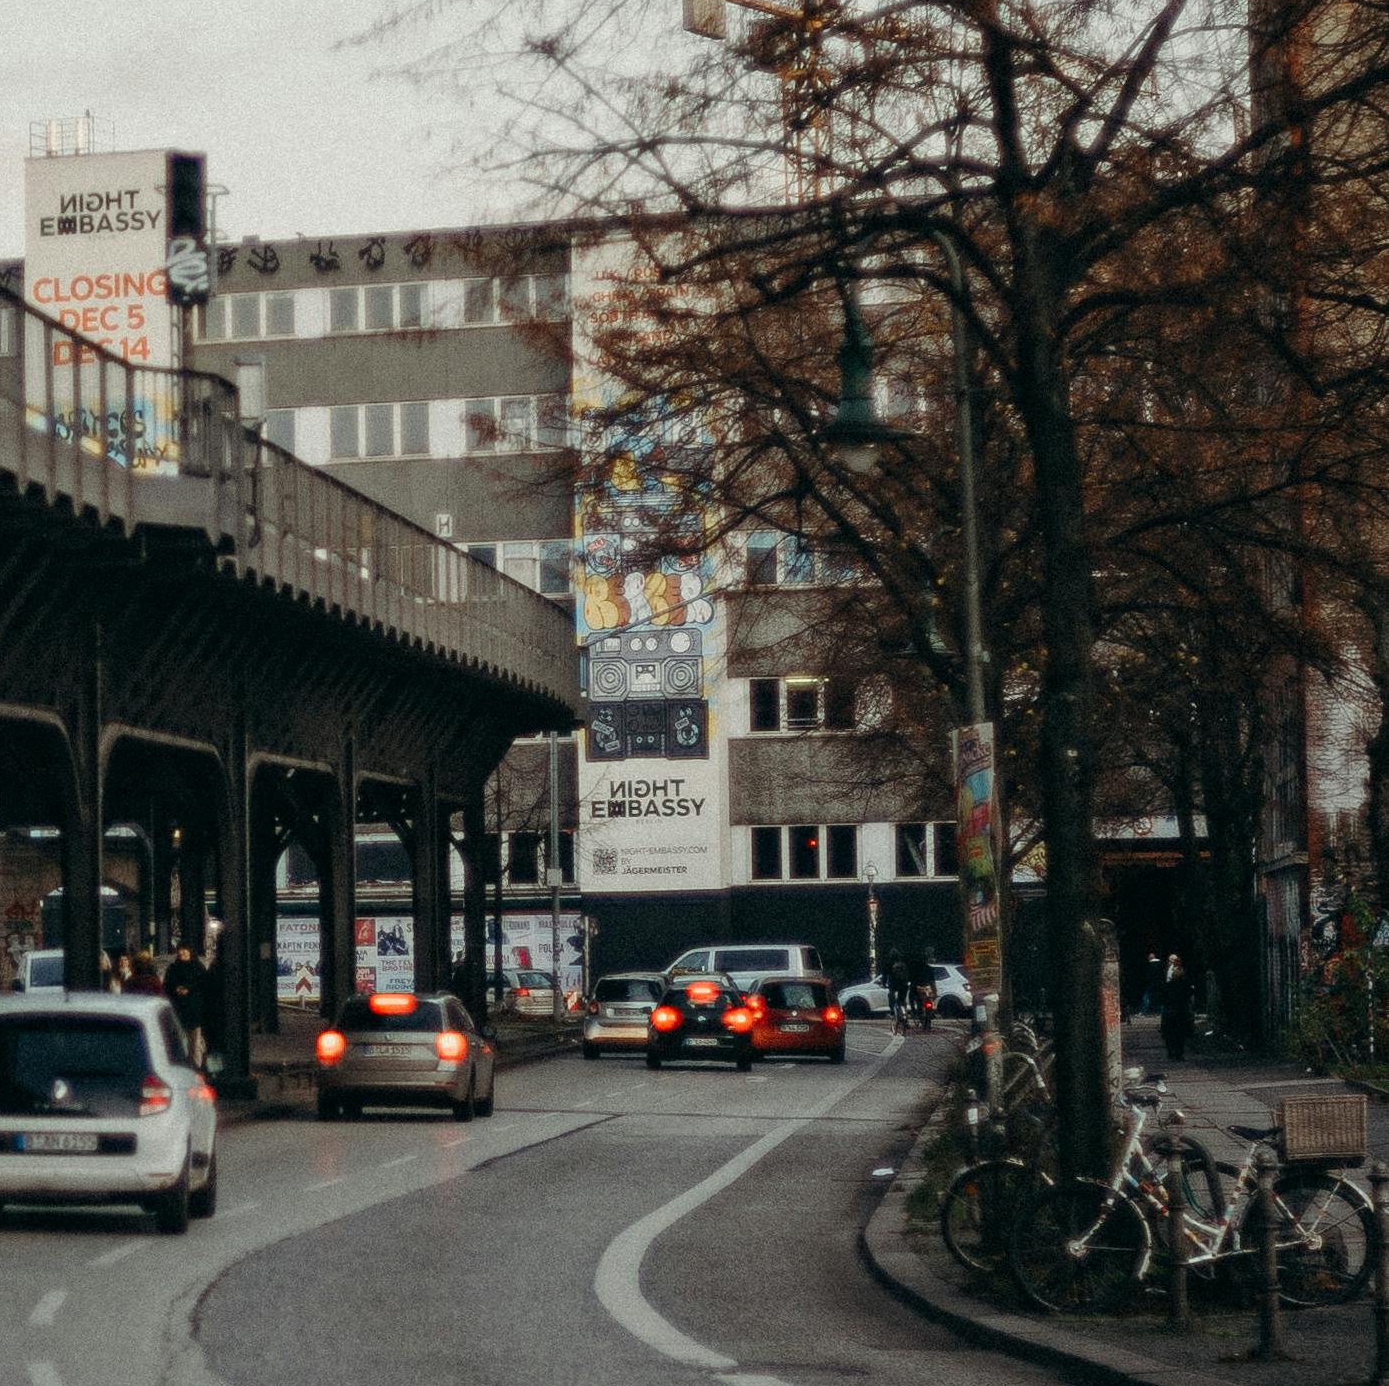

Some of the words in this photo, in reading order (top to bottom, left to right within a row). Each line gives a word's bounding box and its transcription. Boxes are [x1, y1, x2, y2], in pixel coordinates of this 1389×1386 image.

[33, 268, 168, 304] CLOSING
[59, 305, 119, 332] DEC
[127, 304, 145, 330] 5
[120, 335, 150, 361] 14
